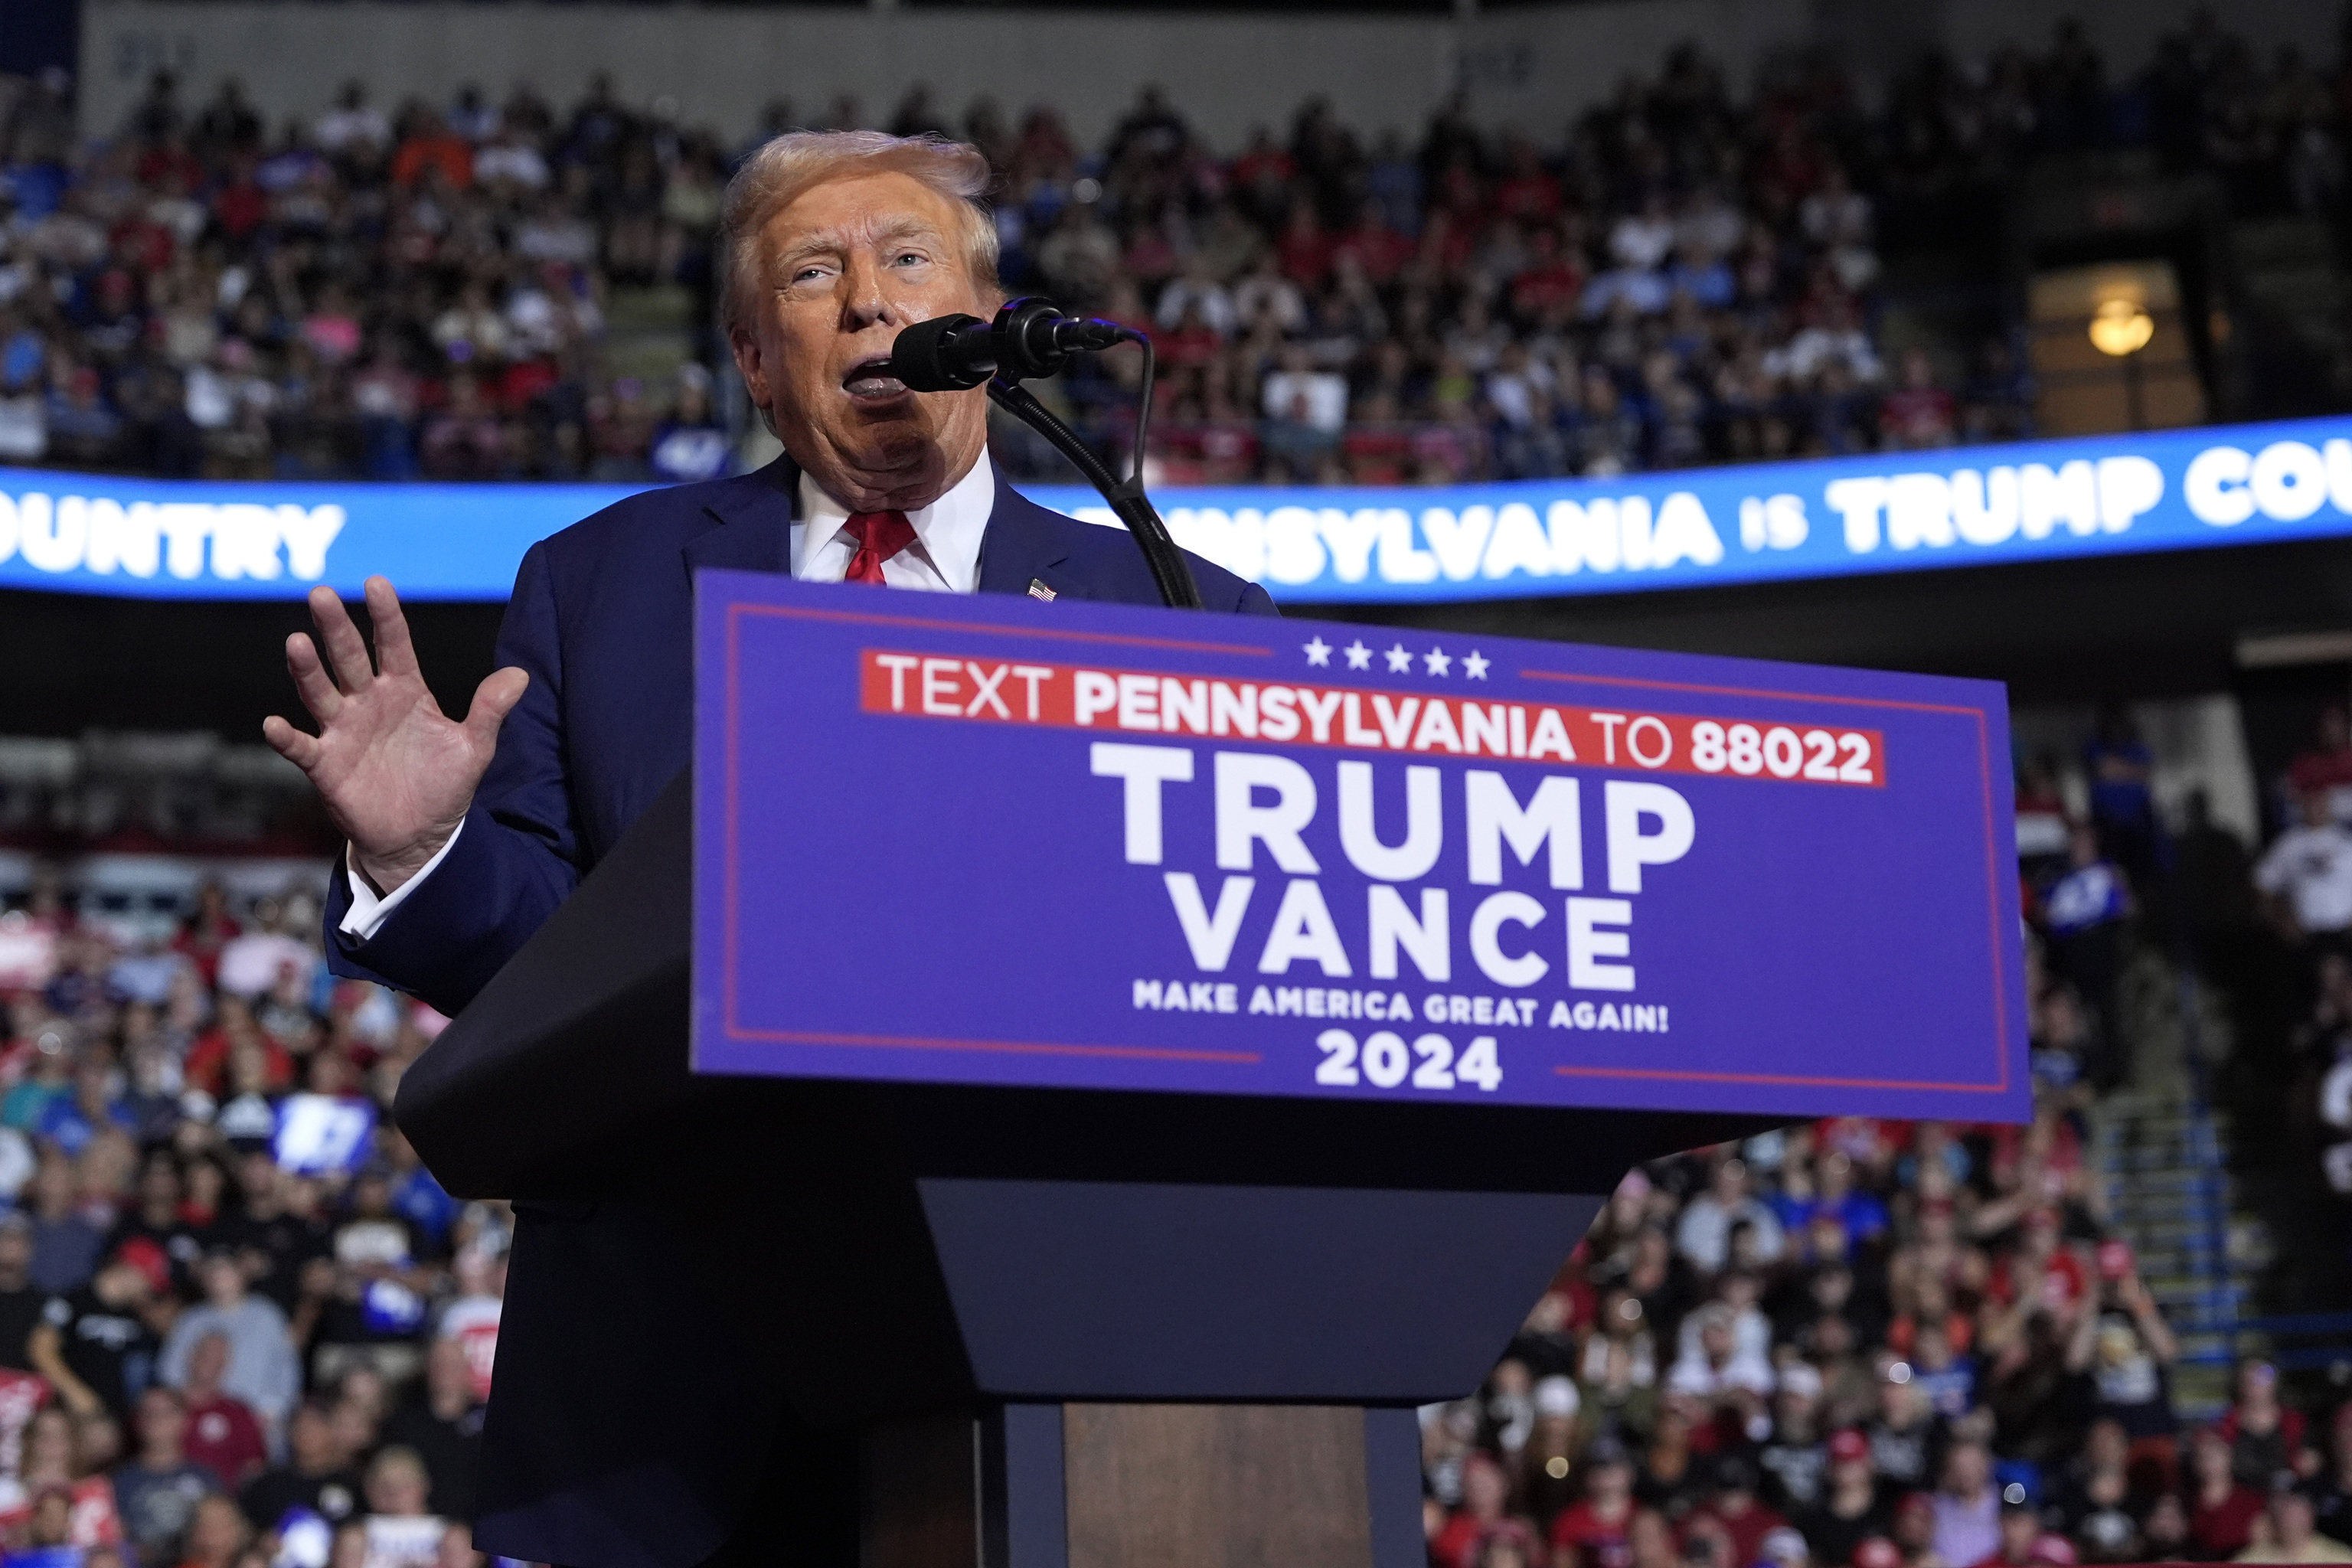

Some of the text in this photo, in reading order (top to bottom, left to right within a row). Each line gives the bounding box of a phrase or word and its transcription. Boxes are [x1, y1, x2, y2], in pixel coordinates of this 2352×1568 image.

[0, 490, 346, 582] UNTRY
[1739, 492, 1809, 552] IS
[1824, 455, 2165, 554] TRUMP
[875, 653, 1874, 783] TEXT PENNSYLVANIA TO 88022
[1089, 741, 1696, 894] TRUMP
[1163, 871, 1637, 991] VANCE
[1132, 979, 1670, 1034] MAKE AMERICA GREAT AGAIN!
[1315, 1028, 1504, 1092] 2024
